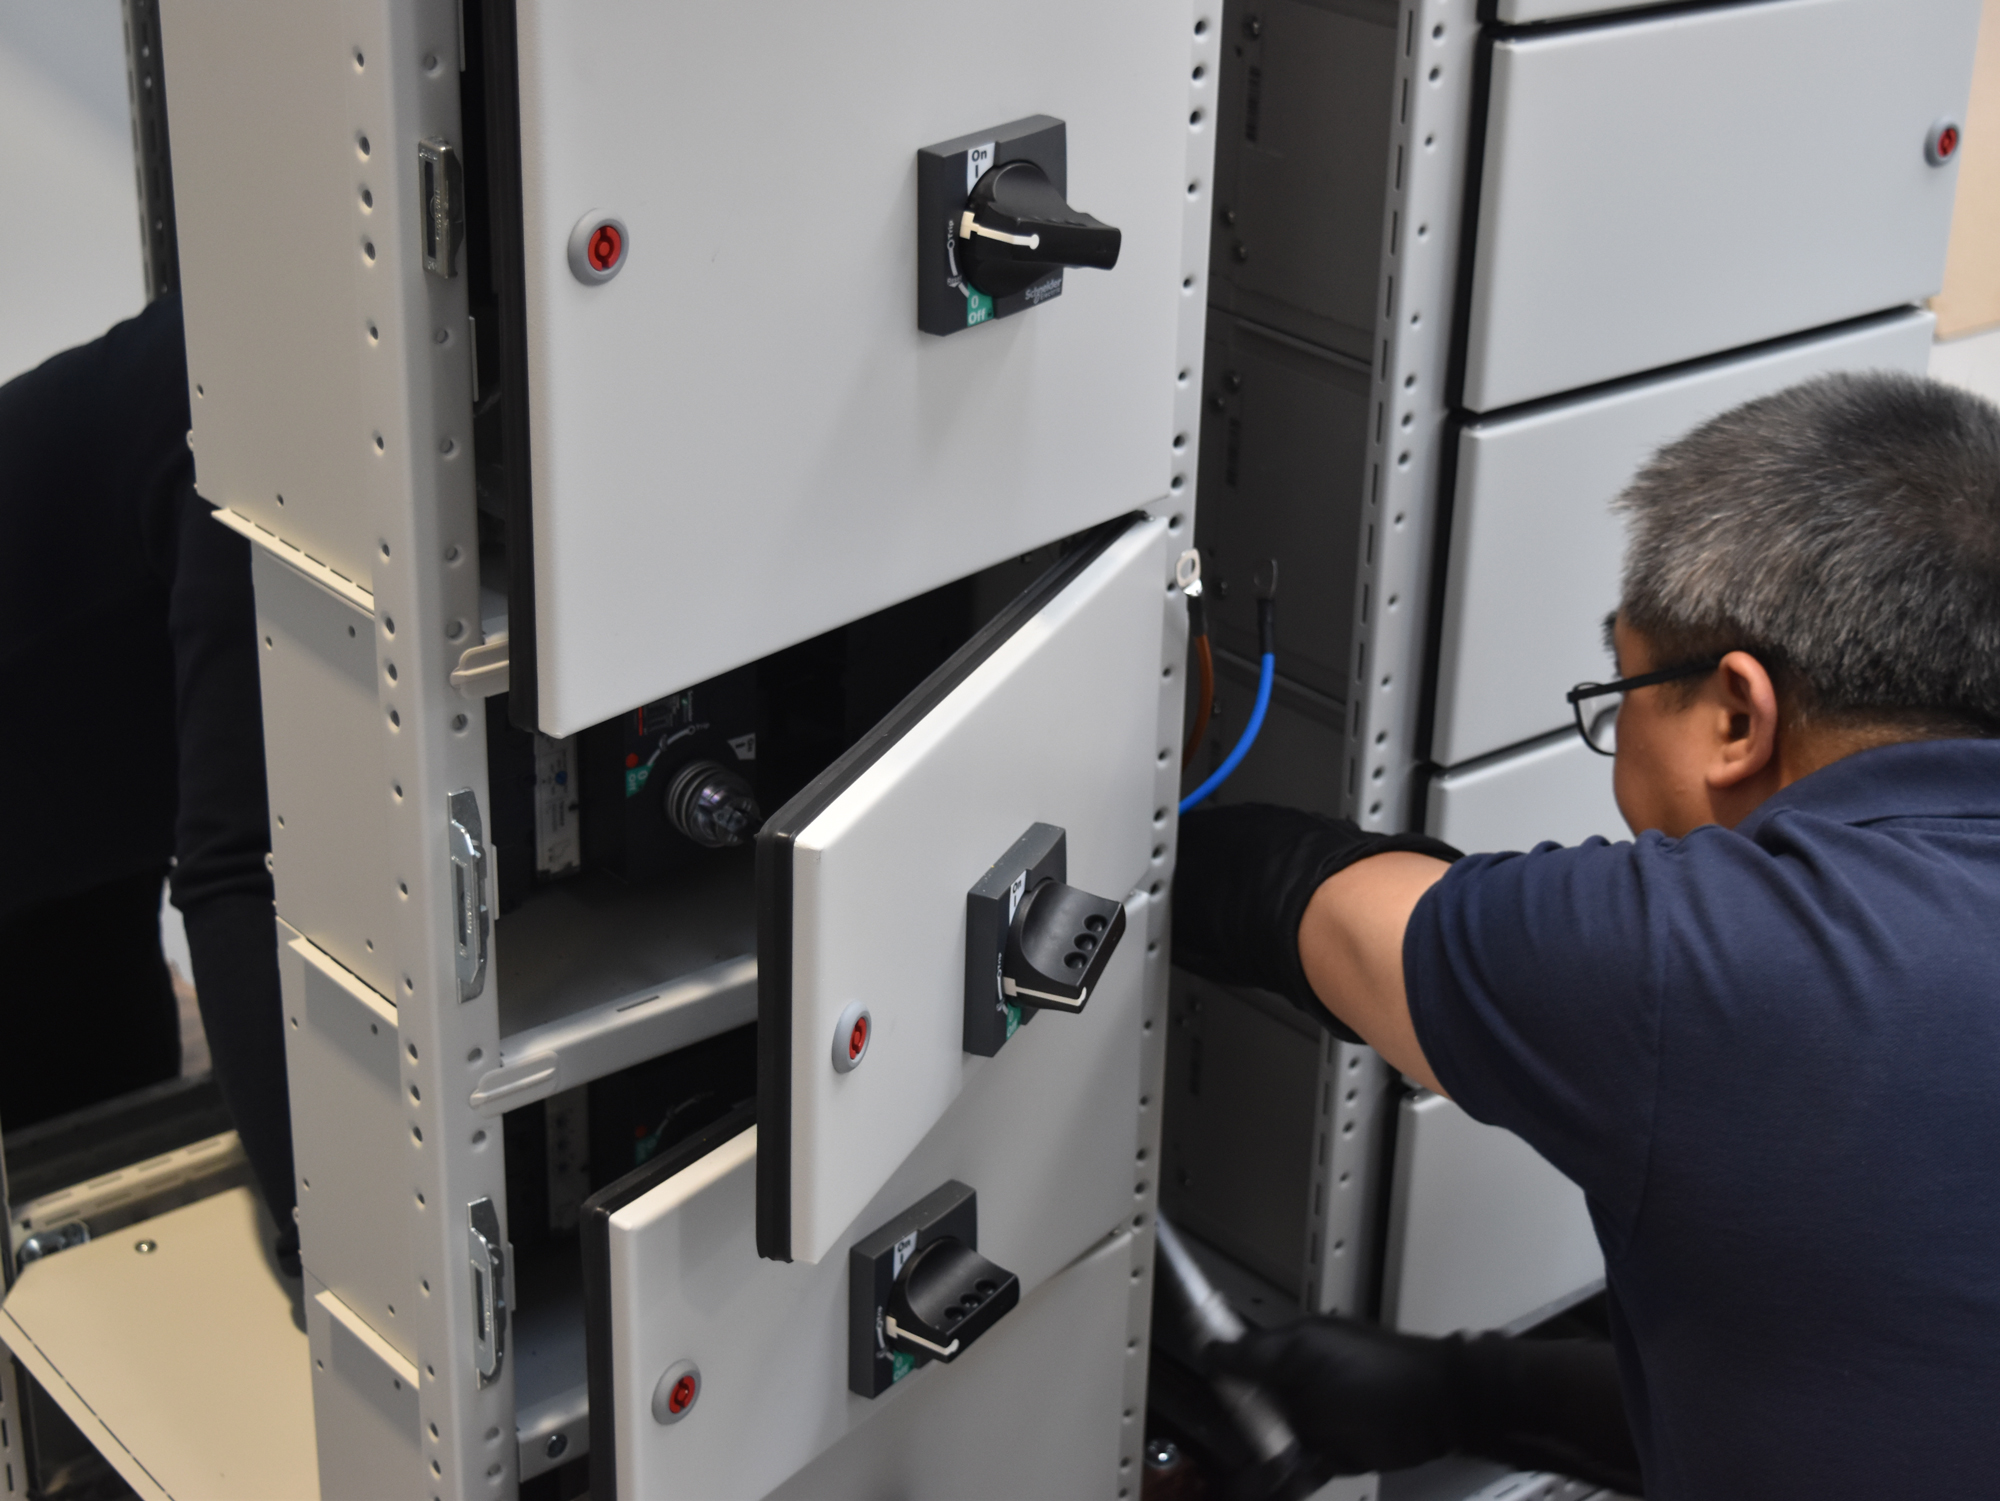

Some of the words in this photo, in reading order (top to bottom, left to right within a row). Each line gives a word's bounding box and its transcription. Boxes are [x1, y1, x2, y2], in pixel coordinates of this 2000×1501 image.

[971, 149, 987, 162] On
[1025, 278, 1062, 304] Schneider
[968, 308, 986, 325] Off
[1011, 881, 1022, 894] On
